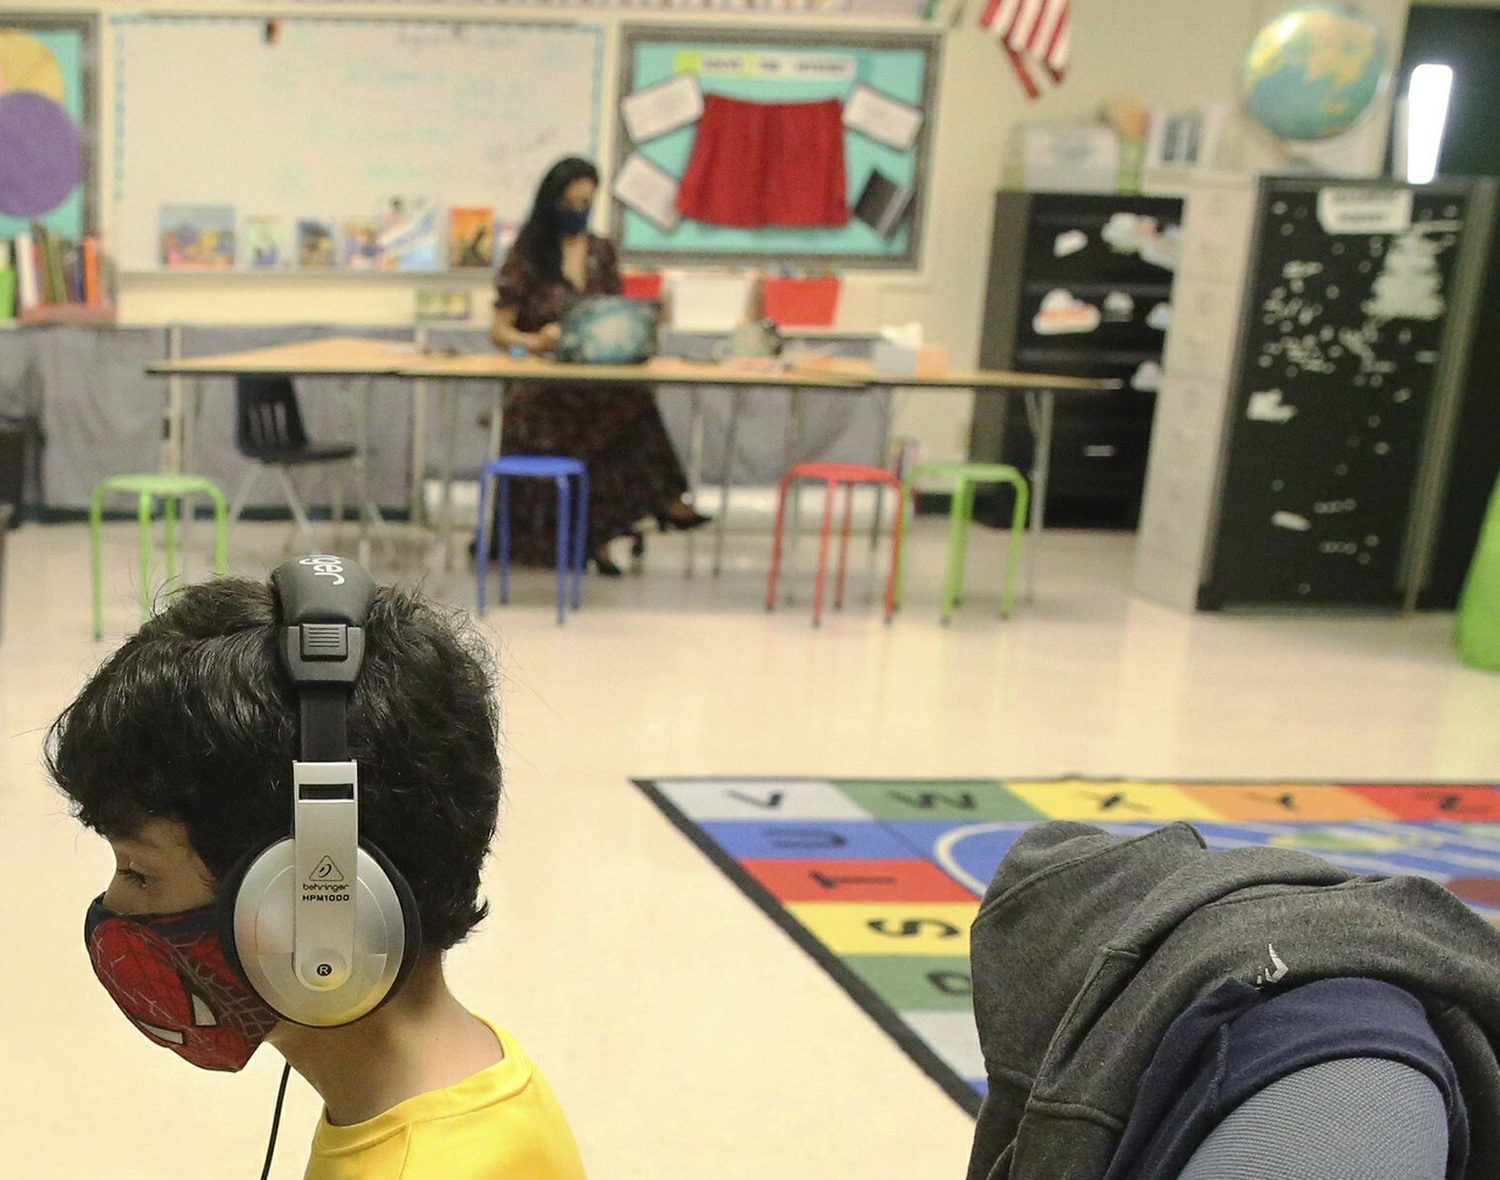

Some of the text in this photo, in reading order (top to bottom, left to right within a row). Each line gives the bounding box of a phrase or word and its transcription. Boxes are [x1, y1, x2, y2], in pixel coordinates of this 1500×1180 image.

[299, 555, 346, 586] ger
[302, 883, 350, 893] behringer
[302, 894, 350, 902] HPM1000
